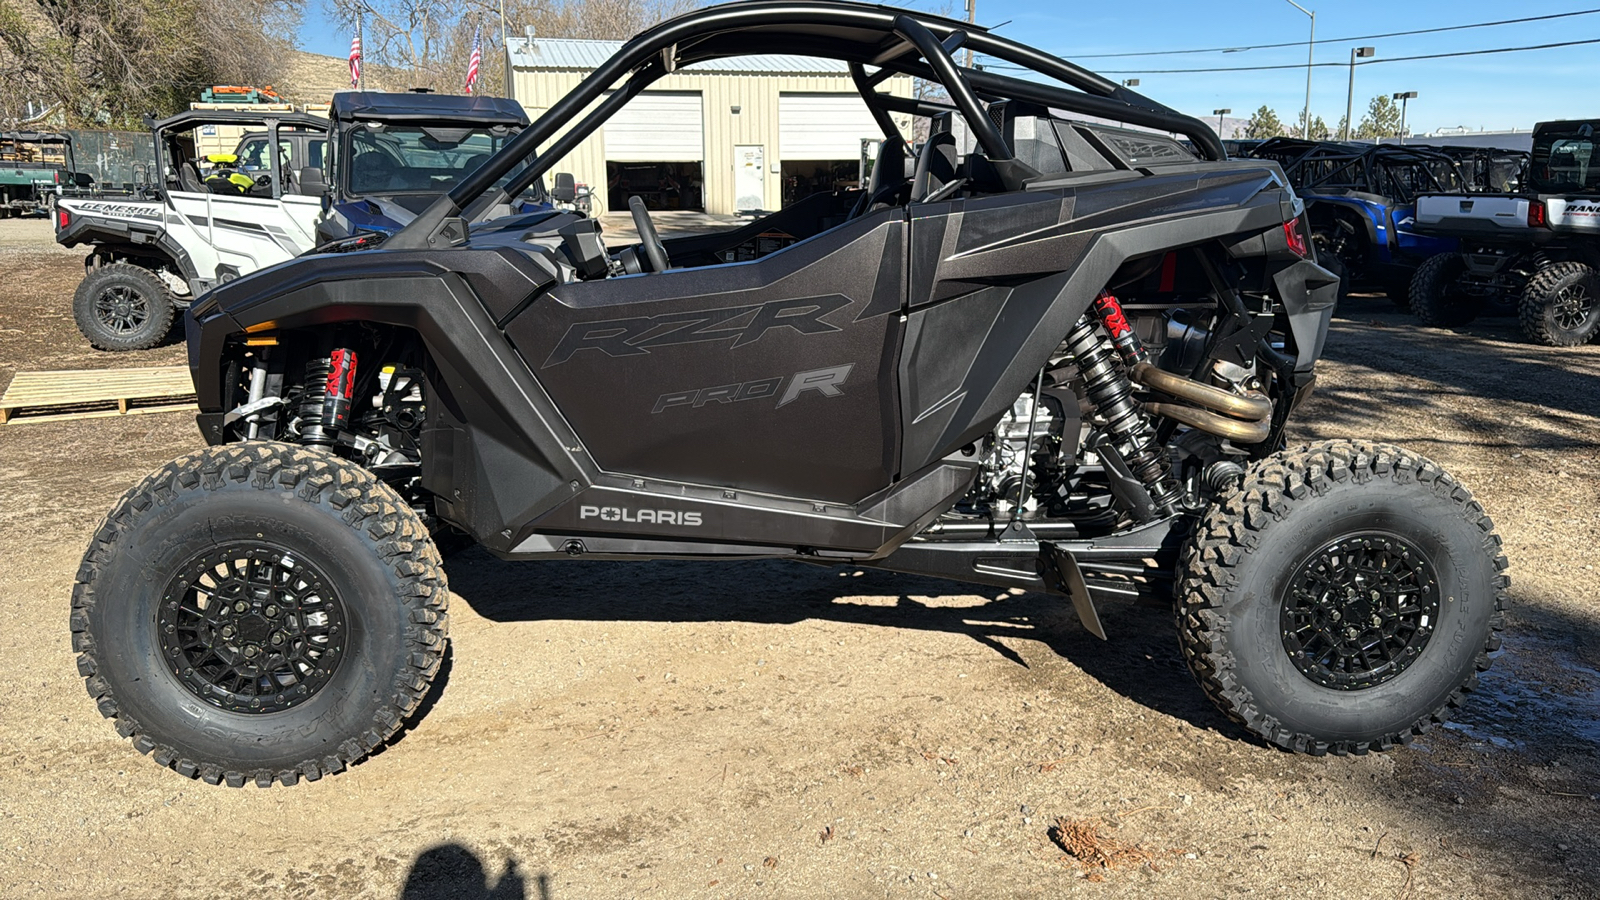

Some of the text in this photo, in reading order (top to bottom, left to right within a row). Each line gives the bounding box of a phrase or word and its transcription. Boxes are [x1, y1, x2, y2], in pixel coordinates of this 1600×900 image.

[79, 202, 159, 217] GENERAL
[541, 293, 855, 369] RZR
[326, 349, 345, 396] FOX
[651, 363, 856, 414] PRO R
[580, 505, 703, 526] POLARIS
